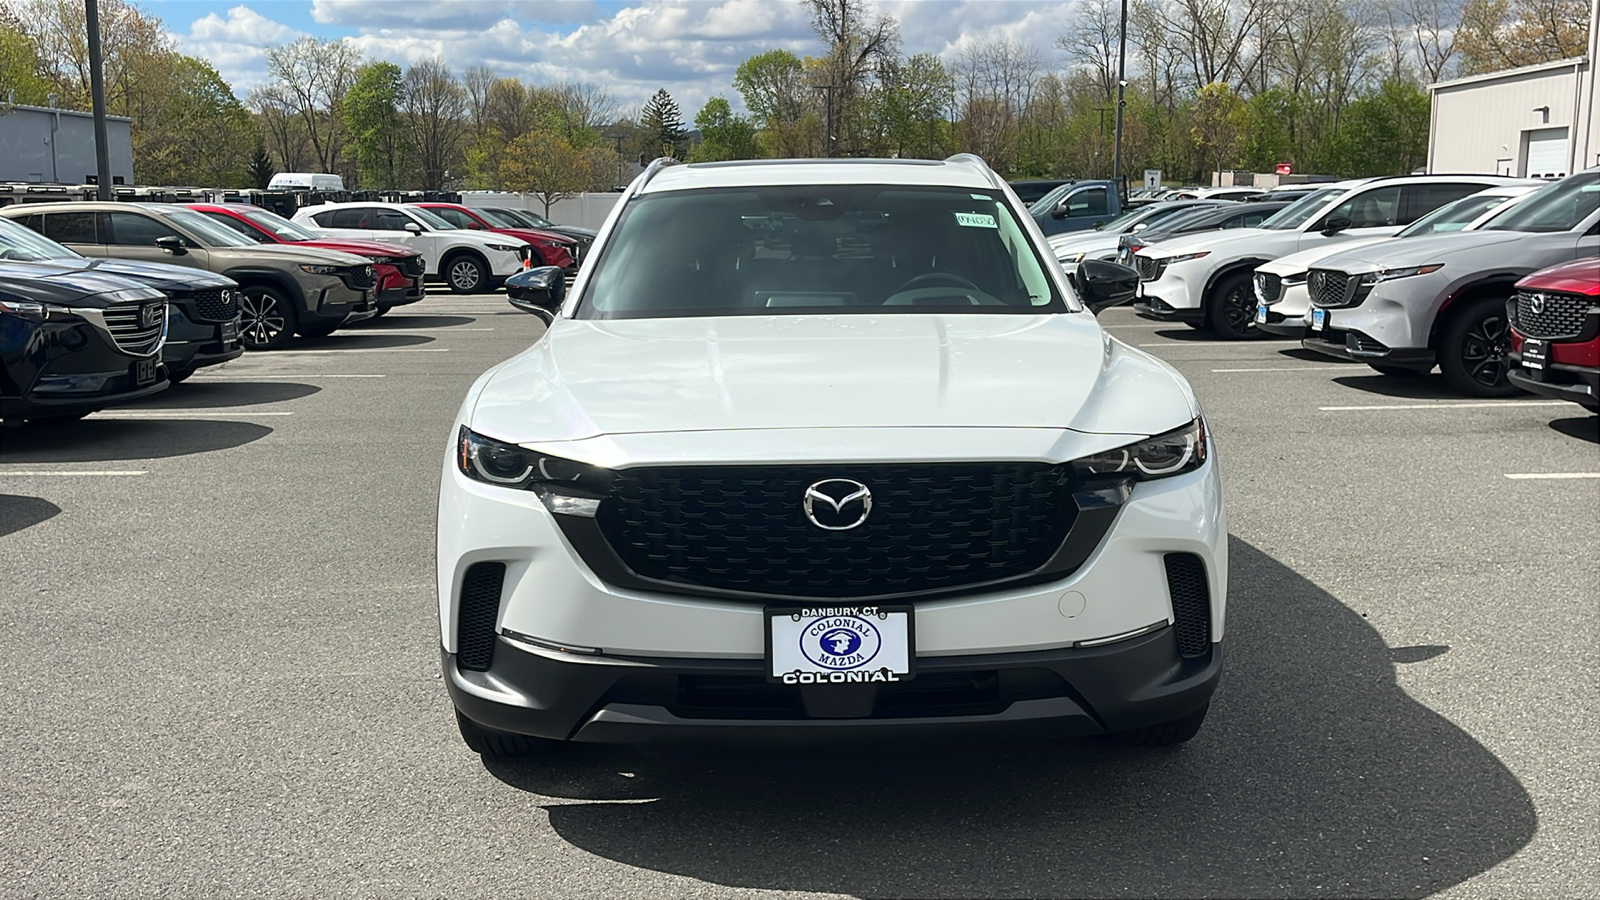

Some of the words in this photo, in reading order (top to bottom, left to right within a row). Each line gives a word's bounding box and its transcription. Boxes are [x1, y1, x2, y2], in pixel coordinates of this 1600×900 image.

[801, 607, 860, 617] DANBURY,
[863, 606, 878, 616] CT
[810, 618, 871, 638] COLONIAL
[818, 652, 865, 667] MAZDA
[783, 671, 899, 684] COLONIAL
